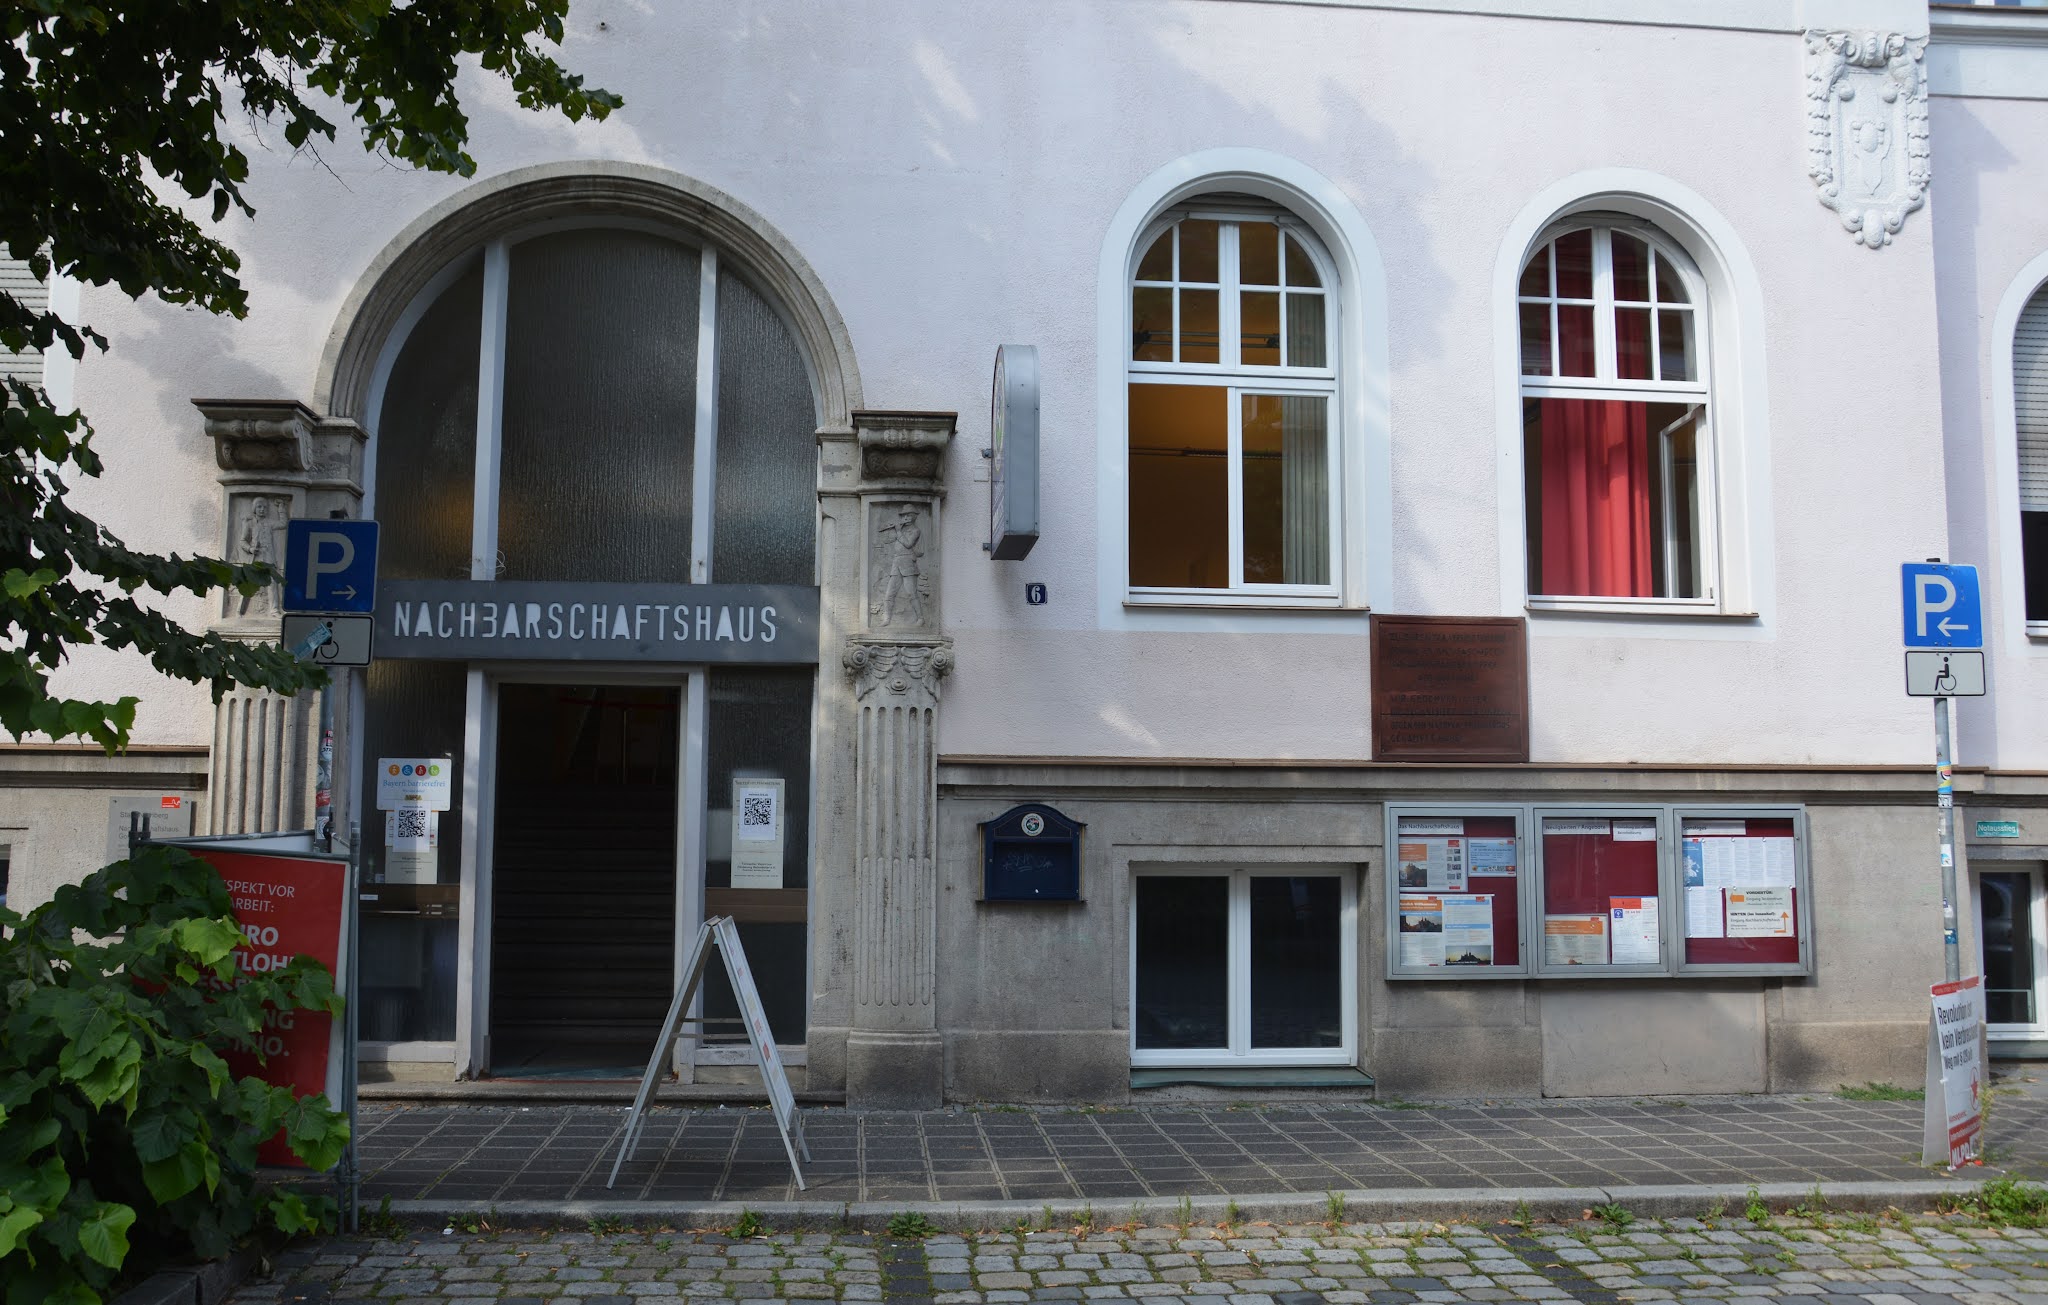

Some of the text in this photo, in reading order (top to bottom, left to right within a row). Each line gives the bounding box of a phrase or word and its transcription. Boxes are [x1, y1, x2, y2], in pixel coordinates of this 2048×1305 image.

[306, 531, 355, 600] P
[1031, 585, 1041, 603] 6
[1914, 574, 1957, 637] P
[383, 779, 446, 788] Bayern barrierefrei
[1977, 824, 2017, 834] Notausstieg
[267, 884, 295, 898] VOR
[1937, 1002, 1966, 1025] Revolution
[1941, 1030, 1954, 1050] kein
[1951, 1142, 1969, 1166] MLPD
